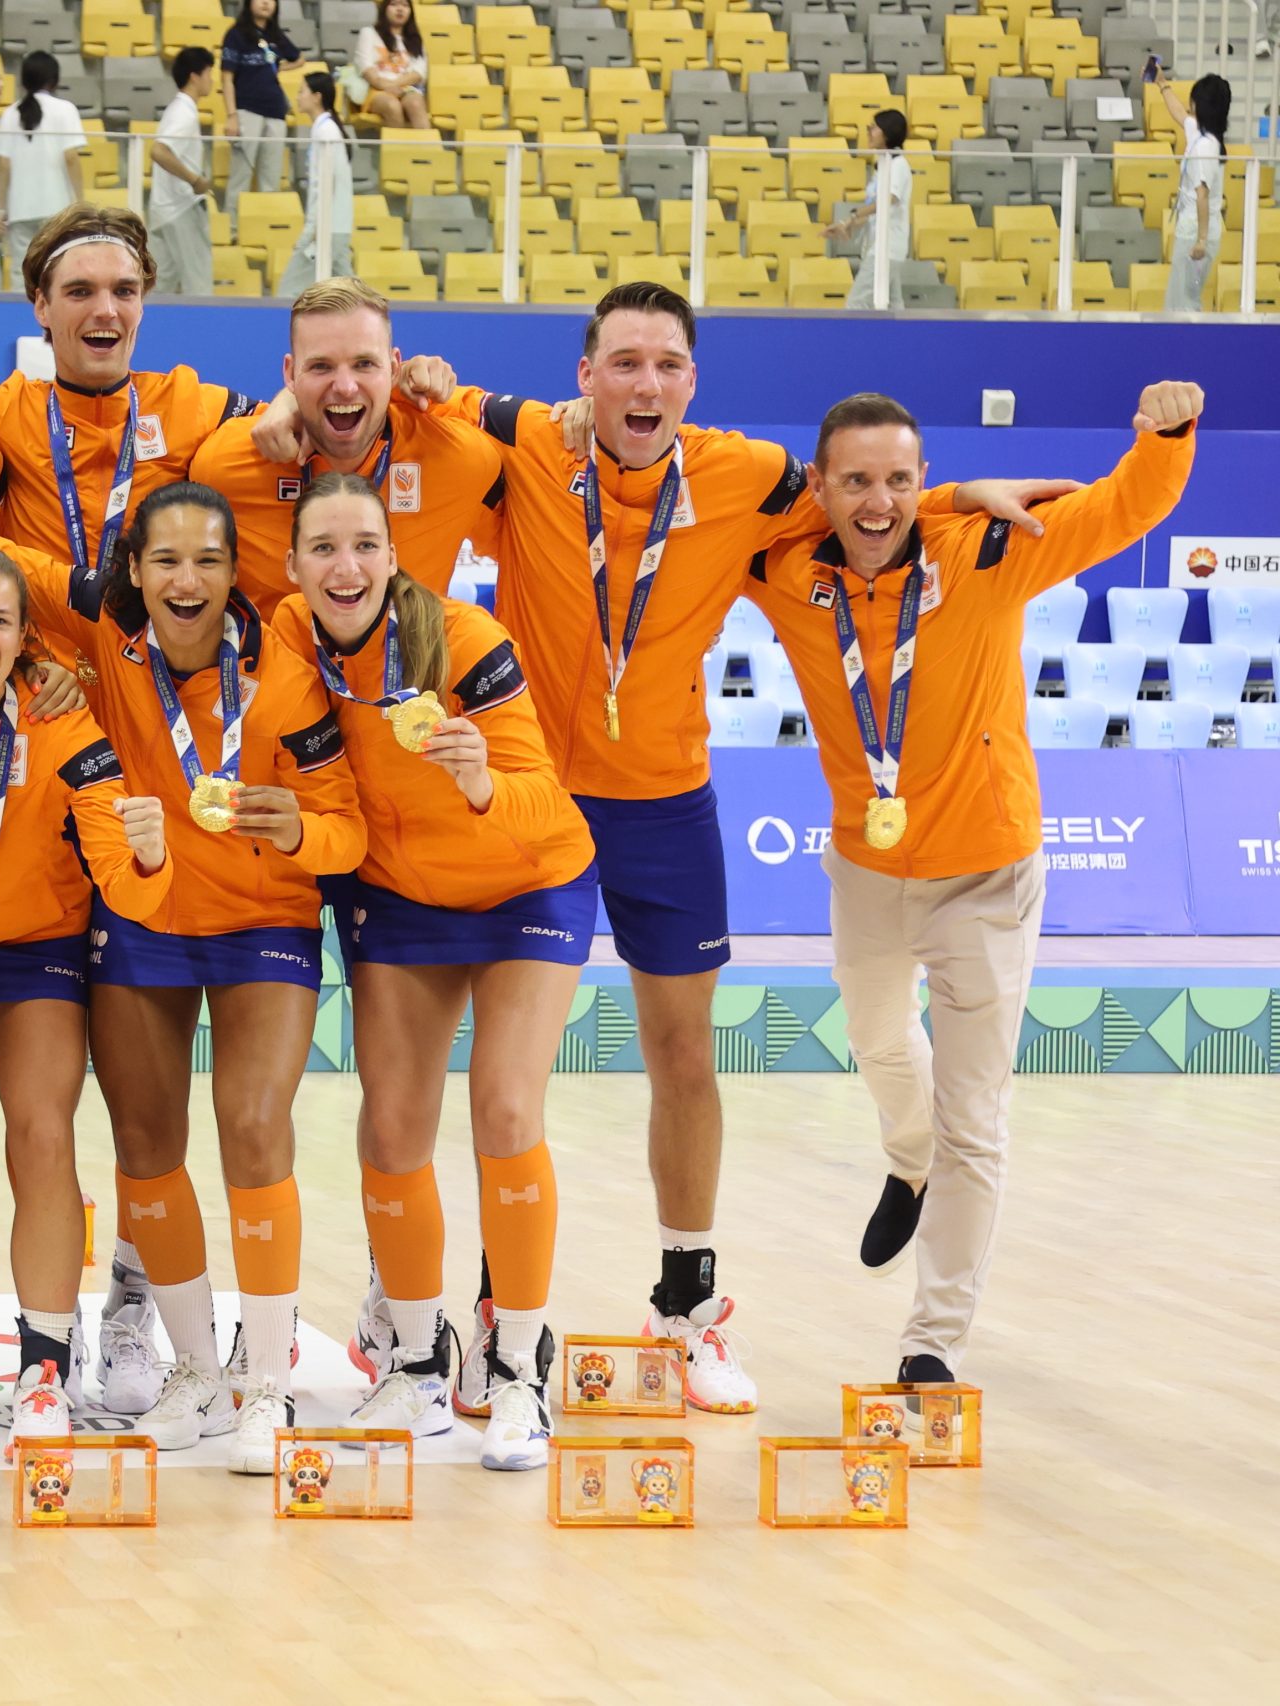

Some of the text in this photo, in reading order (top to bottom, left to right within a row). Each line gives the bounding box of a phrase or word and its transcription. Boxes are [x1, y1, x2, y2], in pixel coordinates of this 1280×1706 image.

[1239, 839, 1280, 864] TI
[1241, 868, 1271, 876] SWISS
[522, 926, 565, 939] CRAFT
[260, 951, 302, 964] CRAFT
[44, 966, 80, 979] CRAFT
